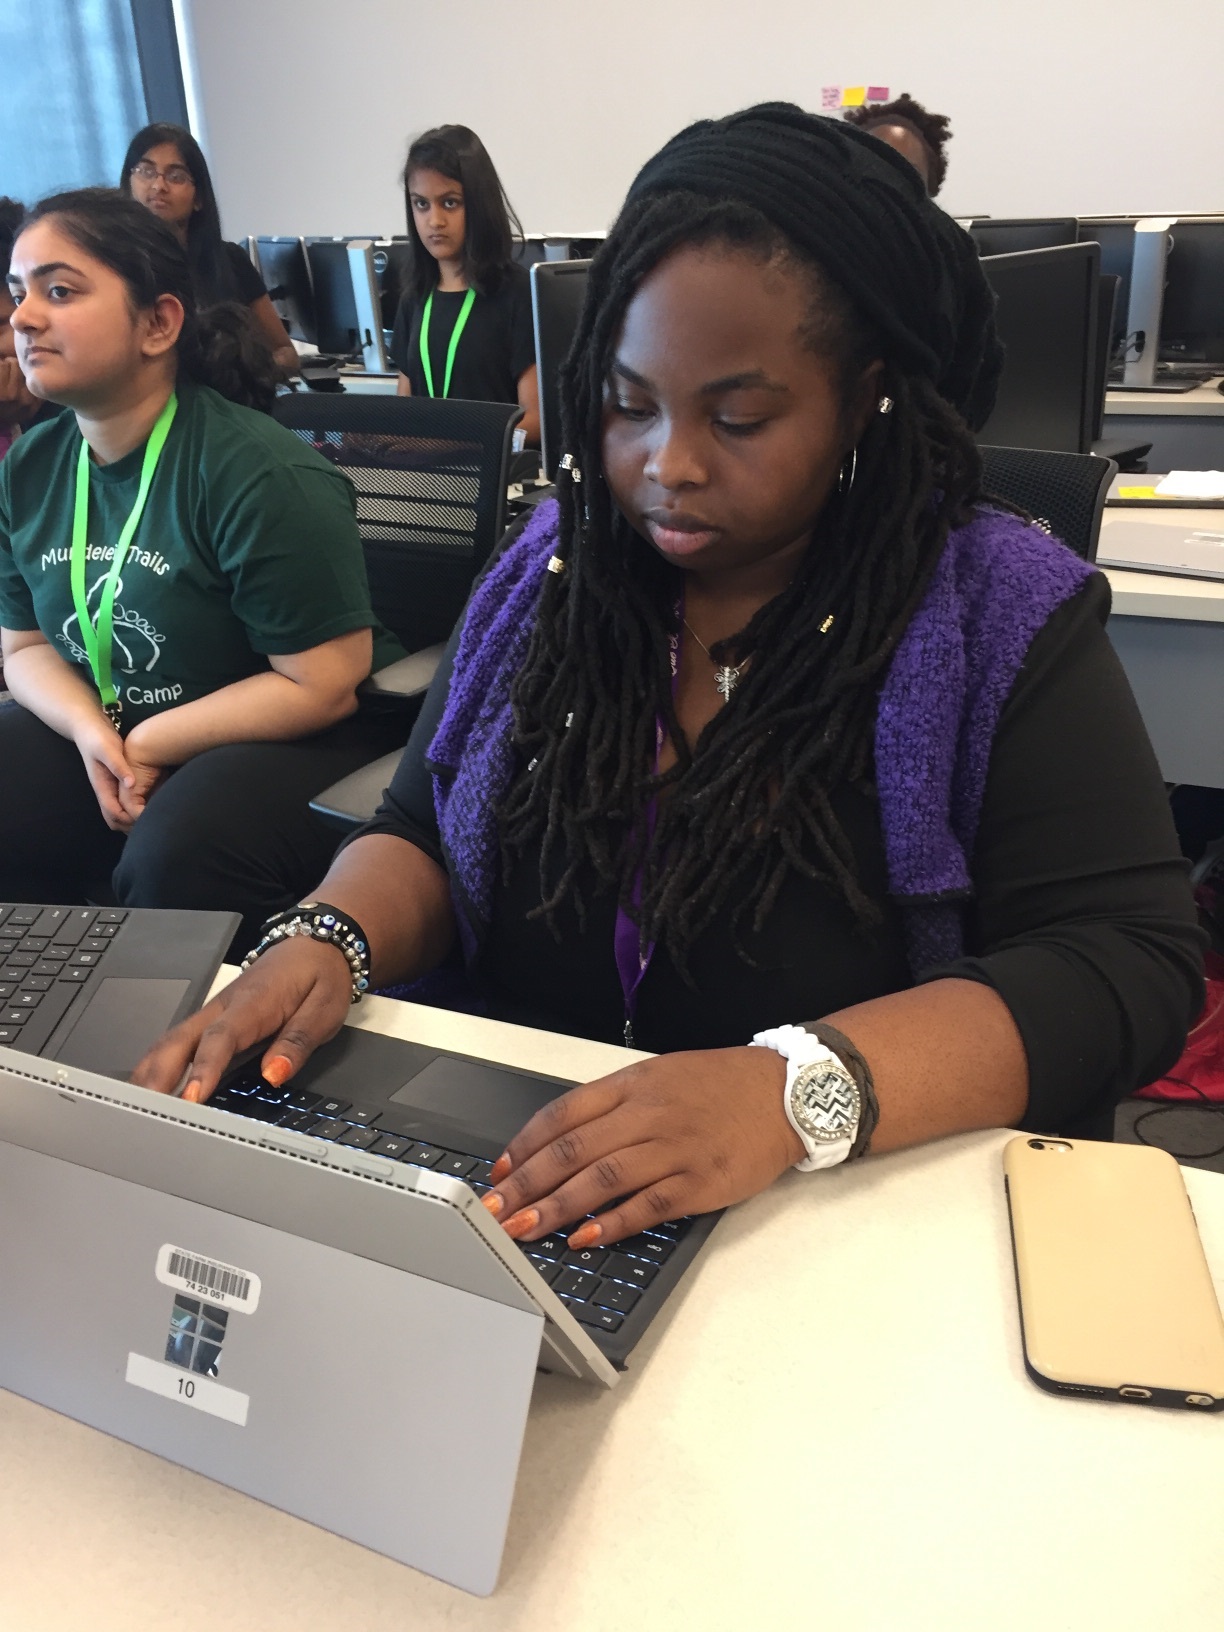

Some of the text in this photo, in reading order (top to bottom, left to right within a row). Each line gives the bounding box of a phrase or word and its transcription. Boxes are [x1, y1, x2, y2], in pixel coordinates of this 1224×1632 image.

[127, 545, 170, 576] Trails
[126, 683, 183, 705] Camp
[541, 1241, 554, 1249] W
[580, 1251, 591, 1260] Q
[185, 1280, 225, 1301] 74 23 051
[177, 1377, 195, 1399] 10
